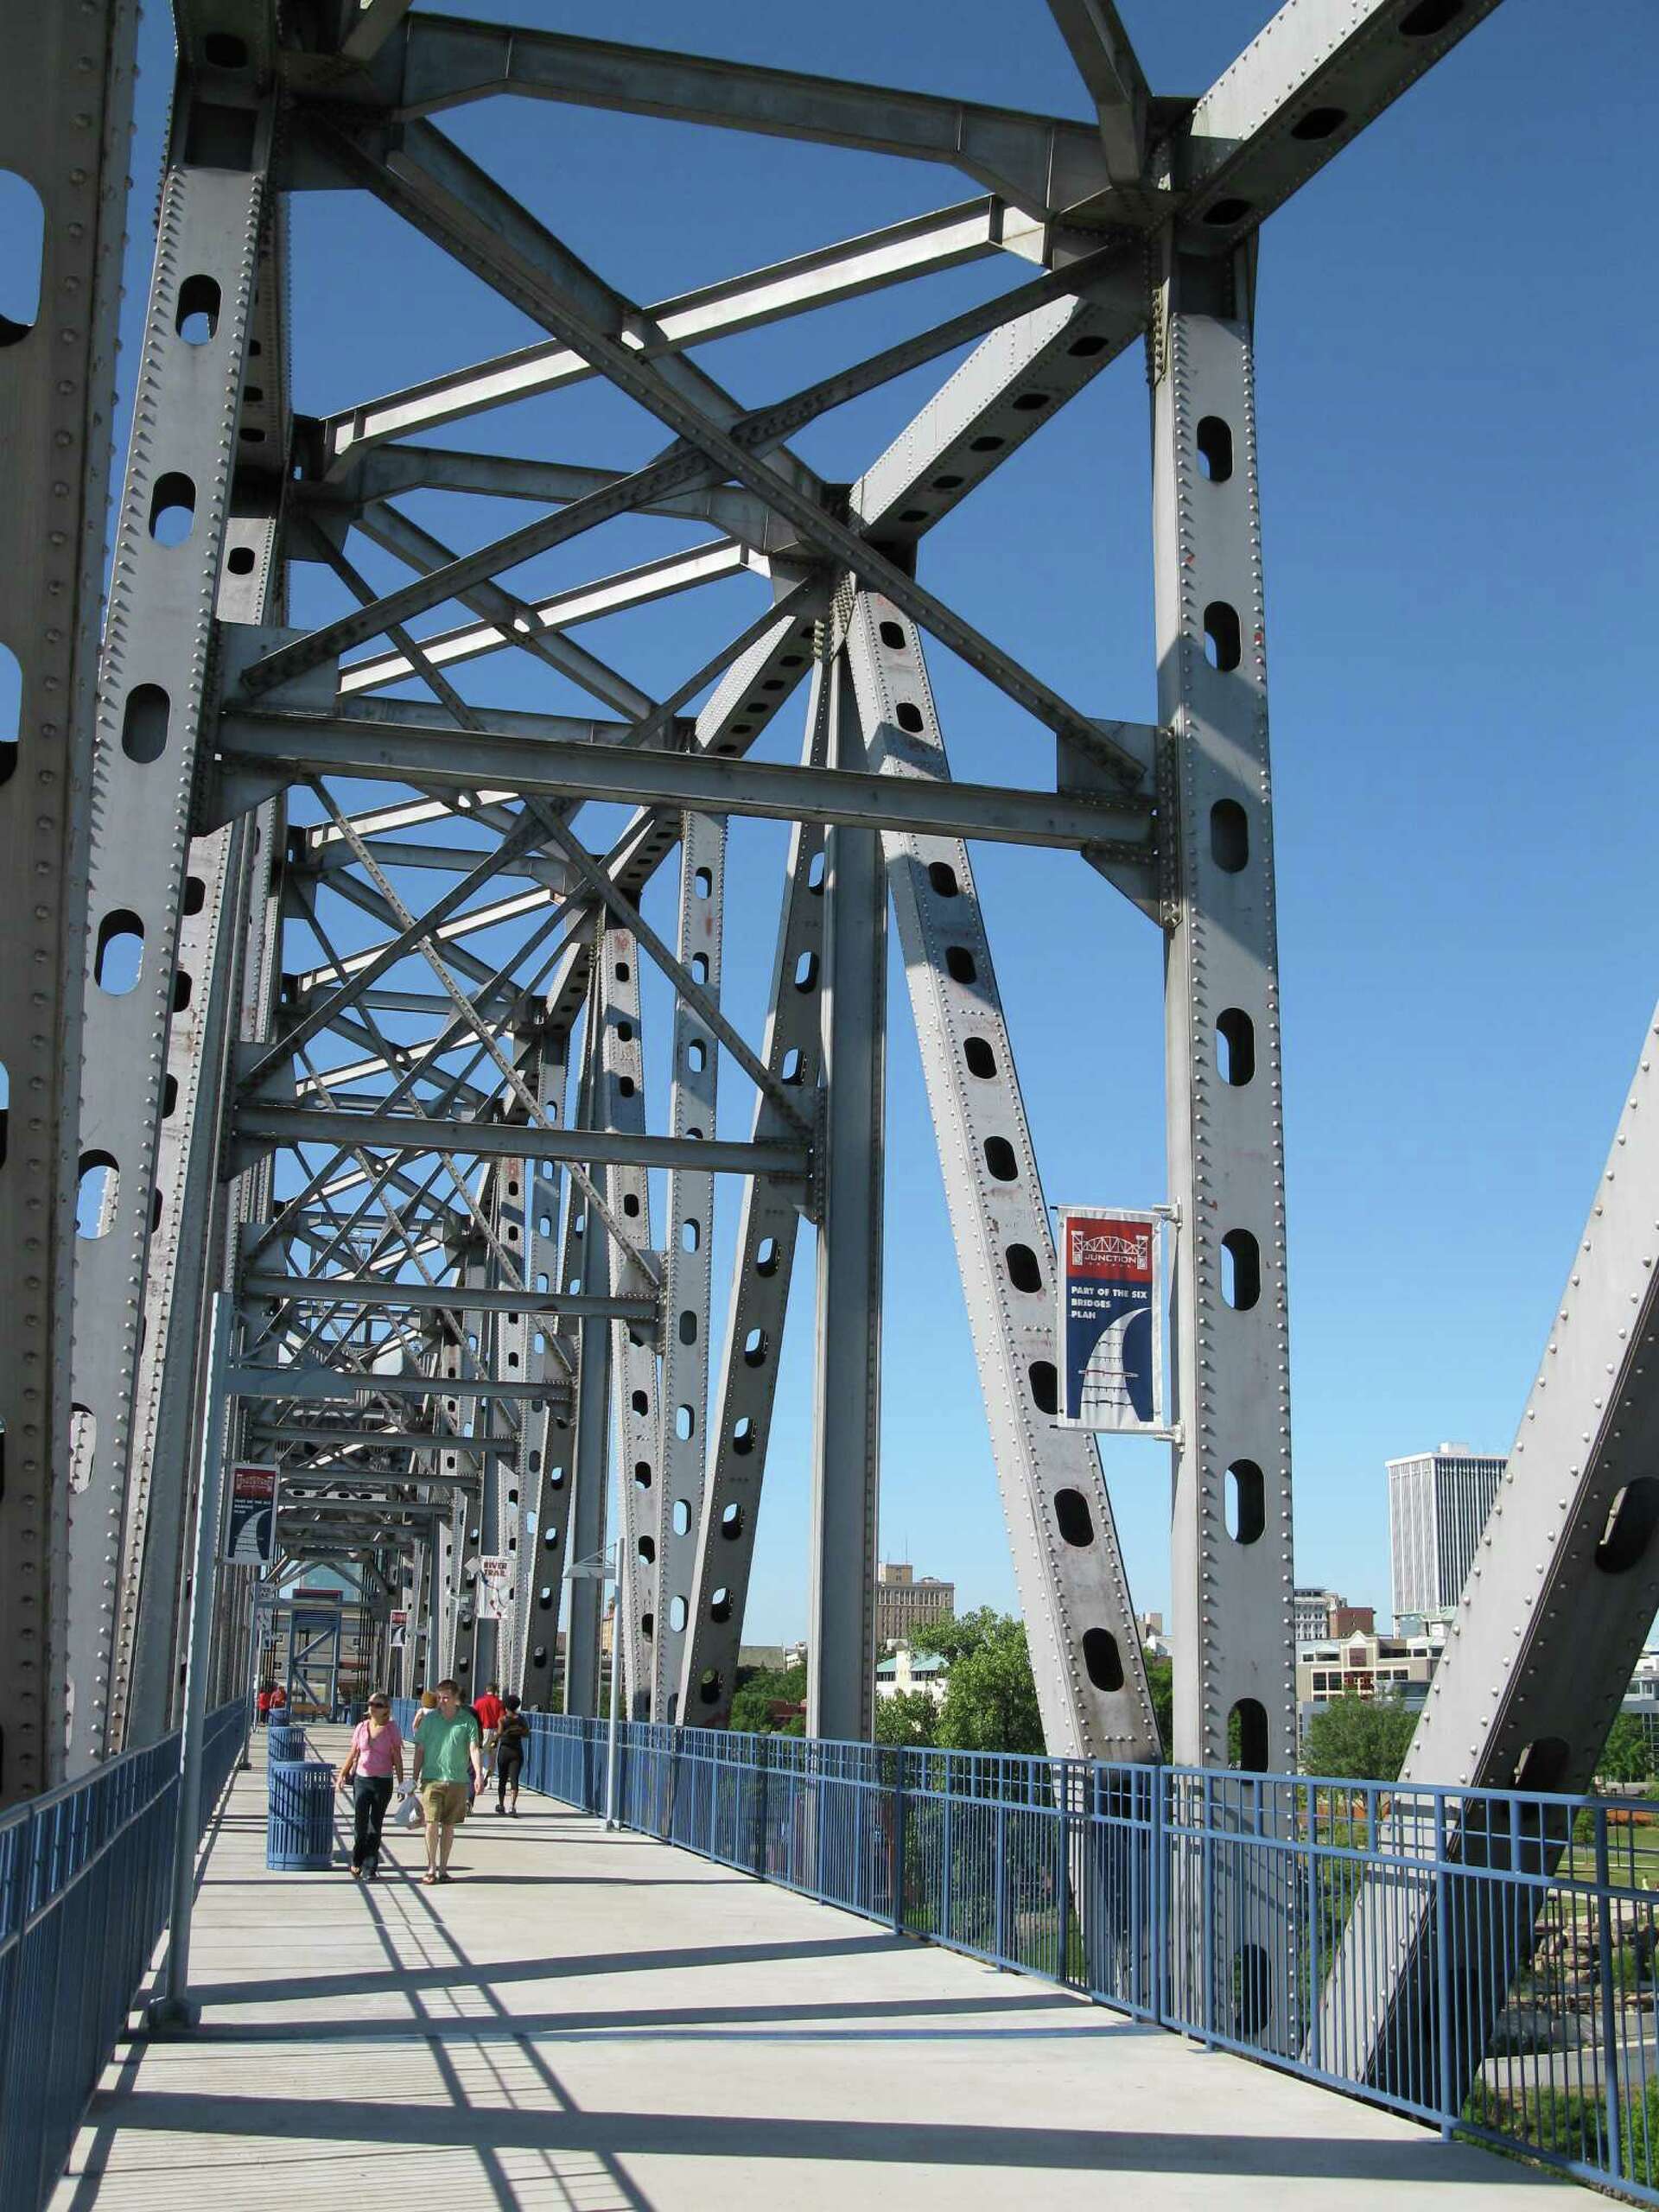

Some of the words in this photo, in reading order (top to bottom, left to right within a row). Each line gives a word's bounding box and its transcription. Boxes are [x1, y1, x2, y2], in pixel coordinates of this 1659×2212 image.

[1084, 1254, 1136, 1263] JUNCTION
[1071, 1286, 1094, 1295] PART
[1096, 1287, 1110, 1297] OF
[1112, 1289, 1128, 1298] THE
[1071, 1298, 1111, 1308] BRIDGES
[1071, 1310, 1096, 1319] PLAN
